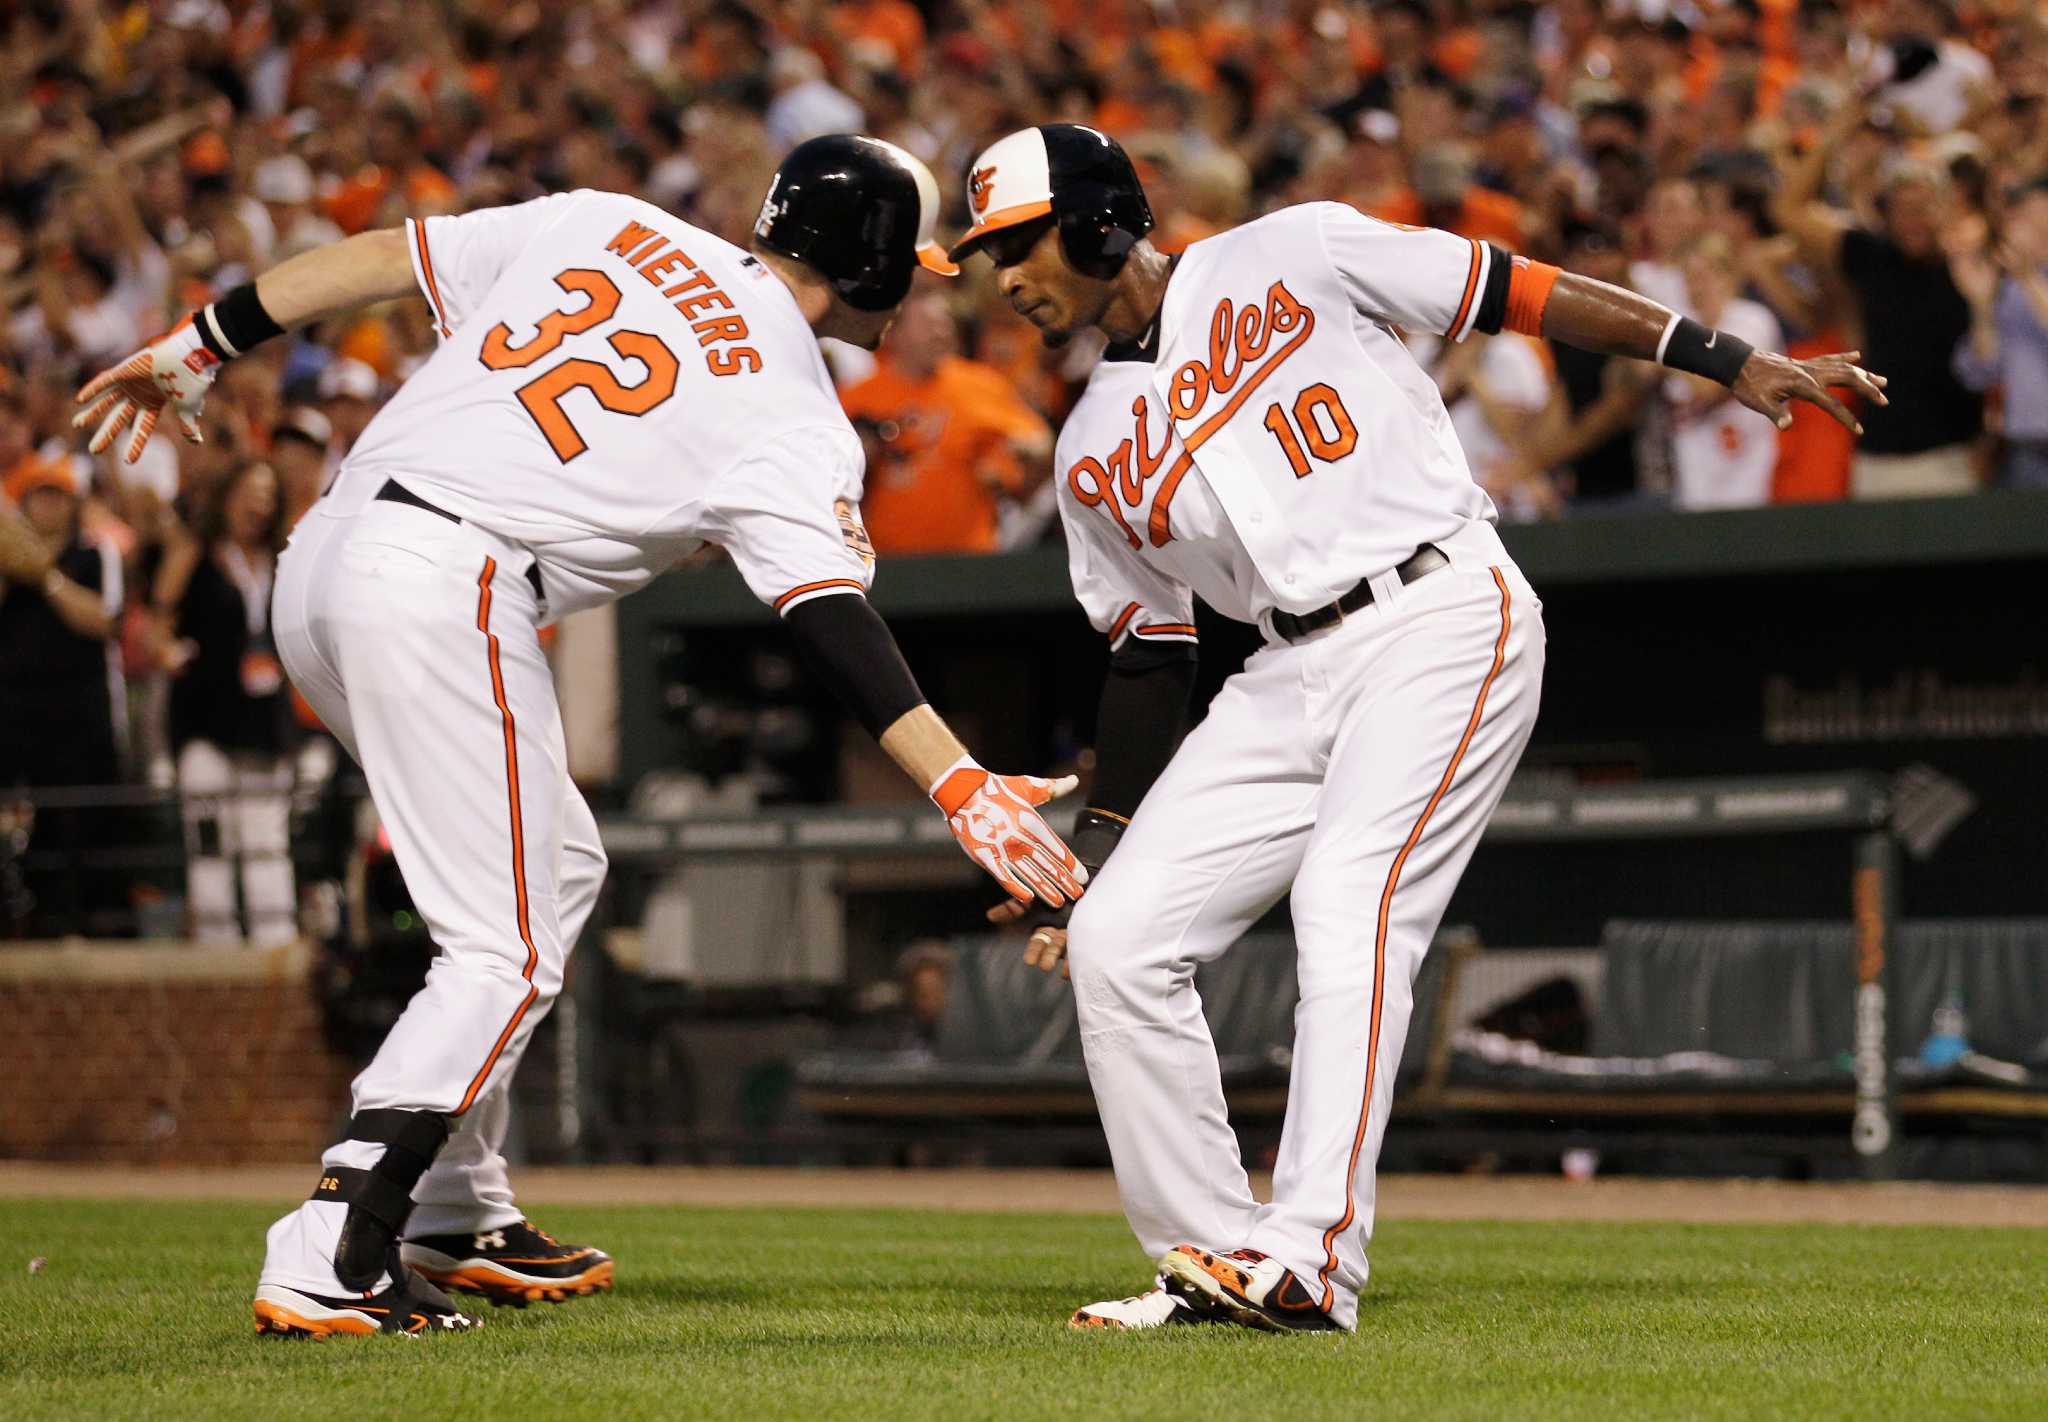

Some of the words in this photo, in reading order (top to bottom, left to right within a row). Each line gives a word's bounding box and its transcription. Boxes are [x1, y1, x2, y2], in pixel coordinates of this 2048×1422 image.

[479, 267, 680, 465] 32
[604, 220, 763, 377] WIETERS
[1068, 278, 1314, 550] Orioles
[1264, 382, 1359, 480] 10
